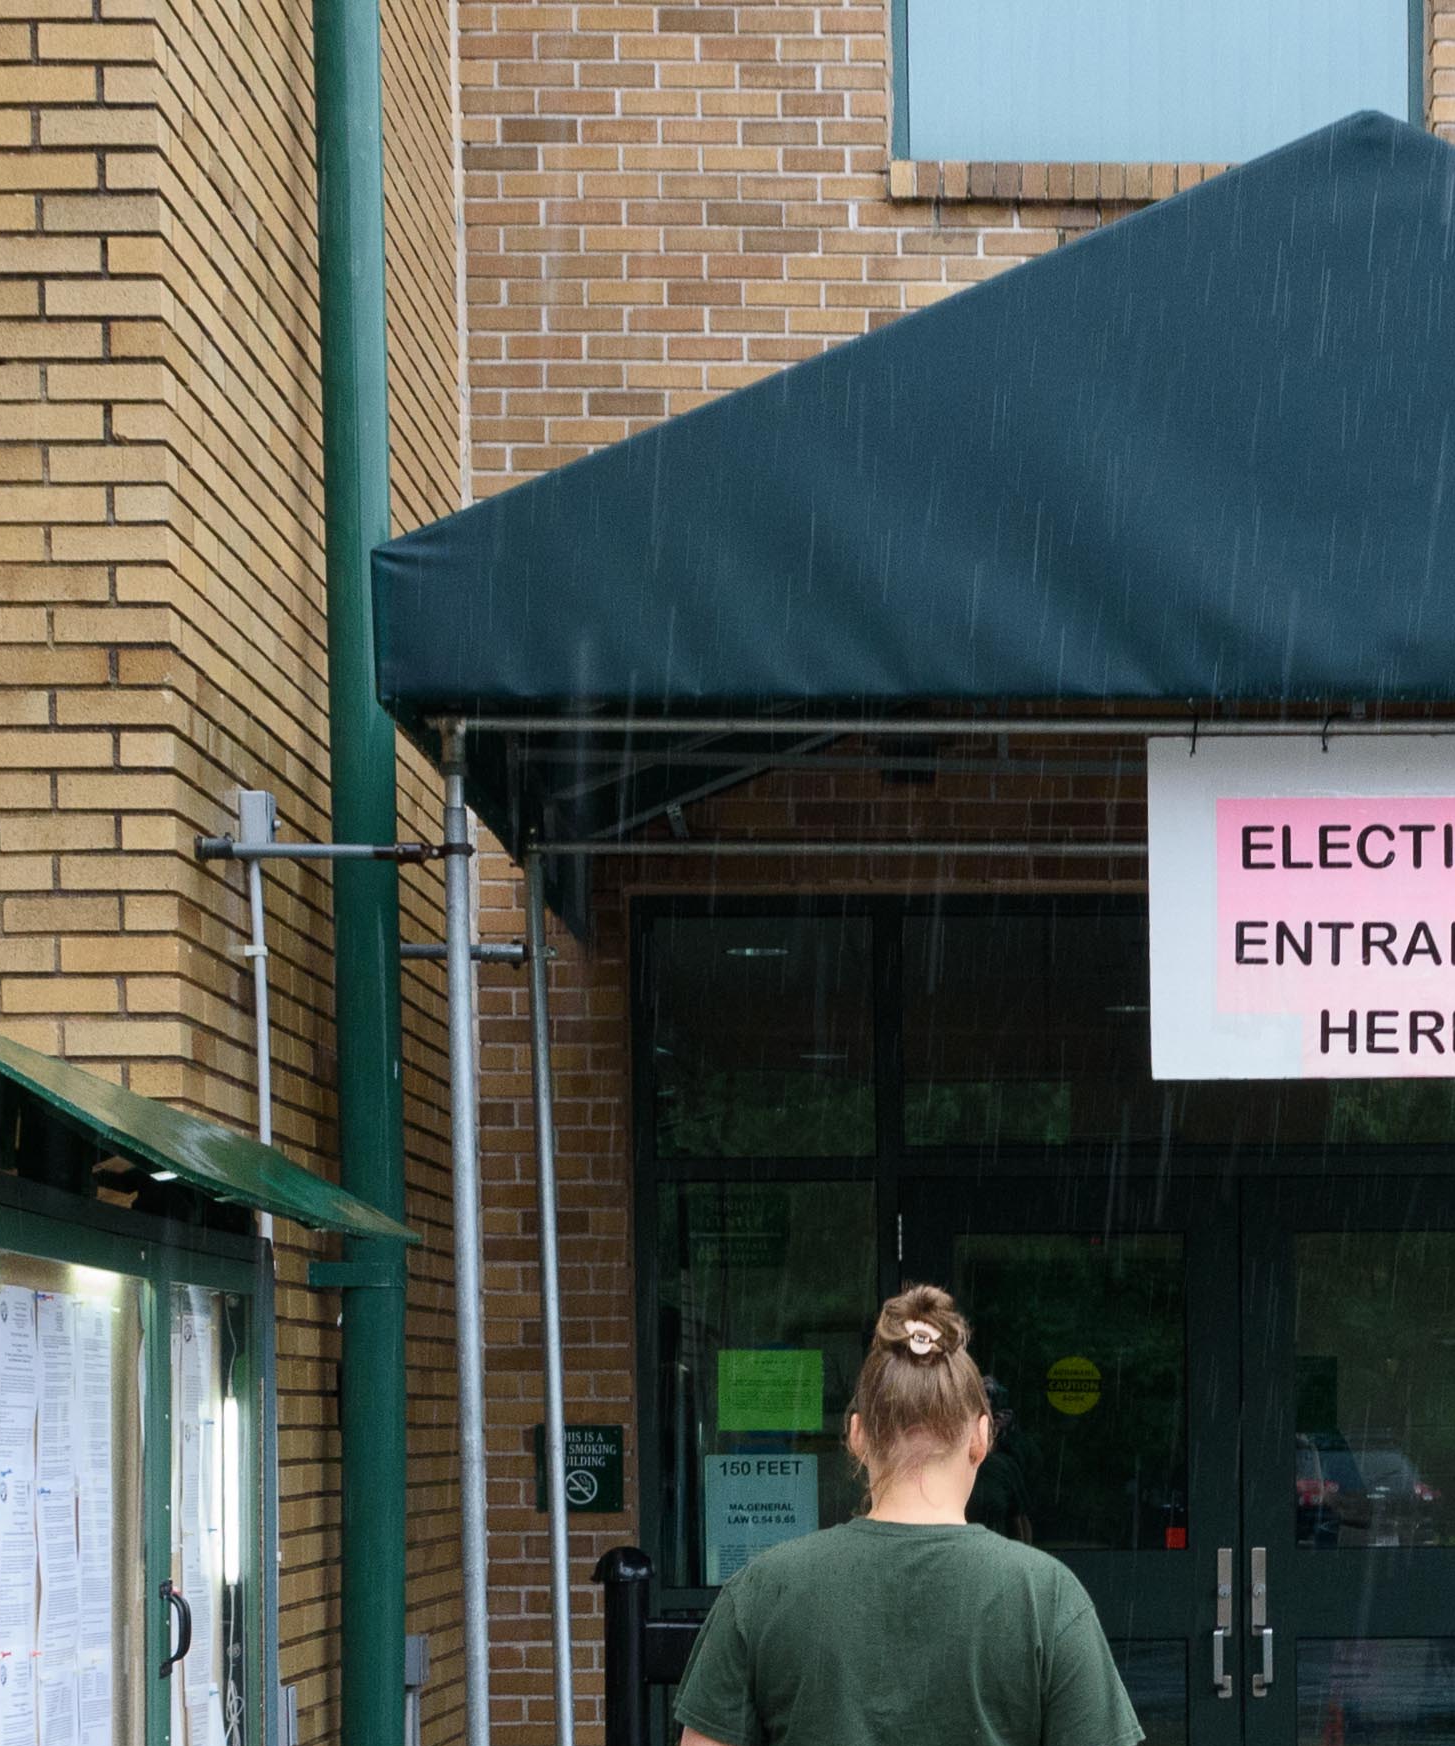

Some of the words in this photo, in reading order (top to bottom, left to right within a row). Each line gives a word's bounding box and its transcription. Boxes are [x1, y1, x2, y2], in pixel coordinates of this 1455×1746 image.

[1048, 1381, 1099, 1391] CAUTION
[584, 1431, 594, 1442] IS
[596, 1431, 604, 1442] A
[568, 1444, 617, 1455] SMOKING
[565, 1456, 606, 1467] UILDING
[719, 1461, 751, 1477] 150
[756, 1460, 803, 1476] FEET
[728, 1515, 750, 1525] LAW
